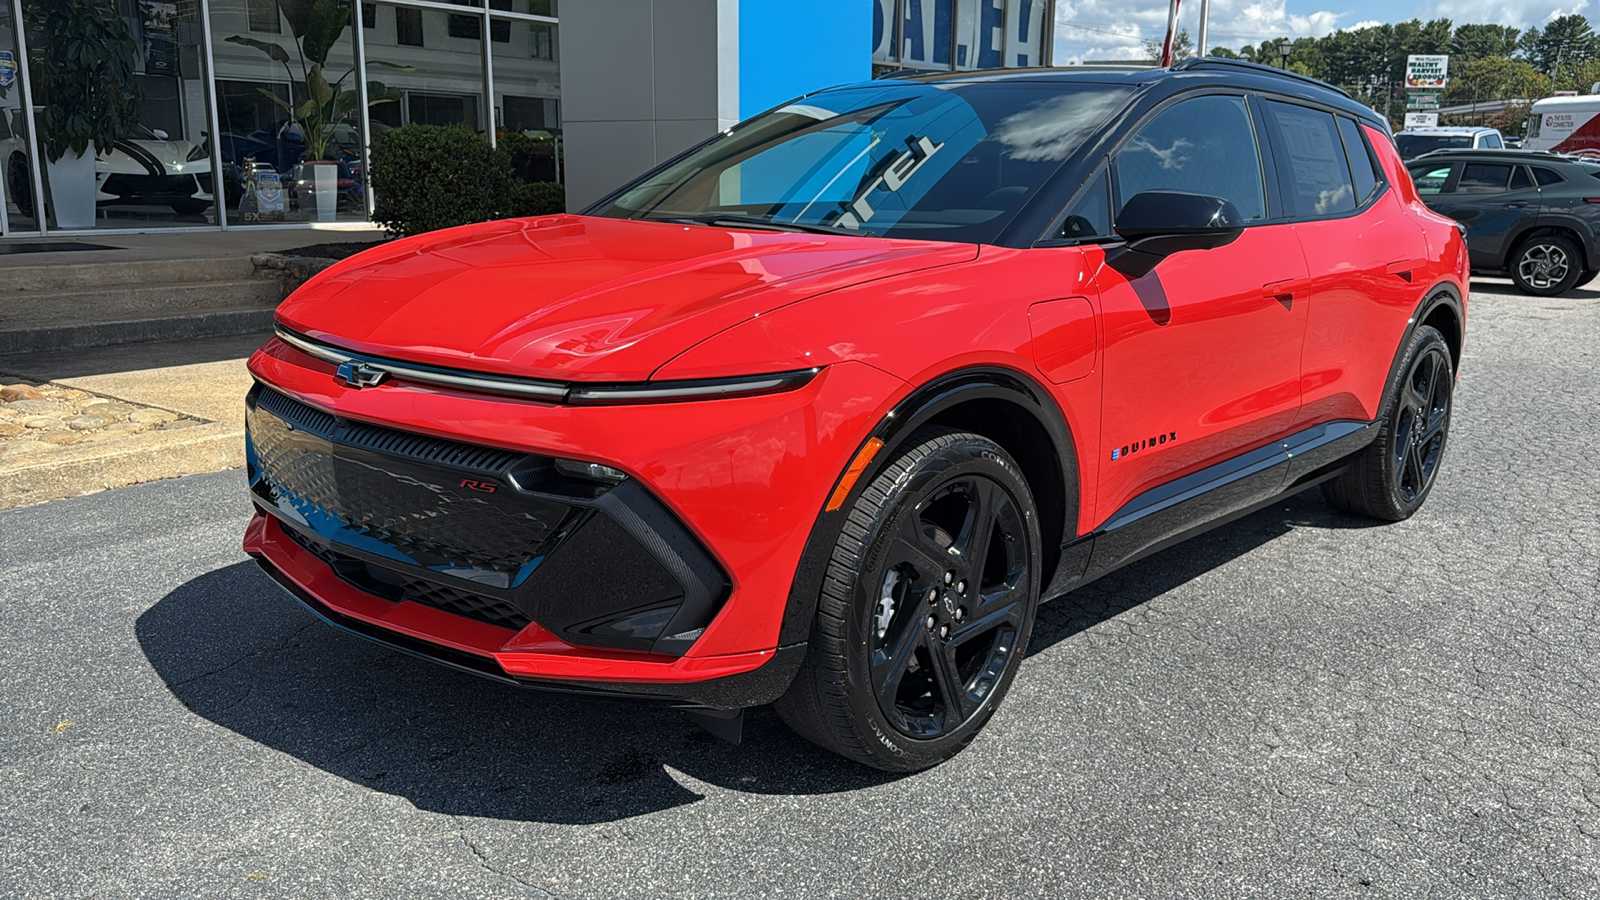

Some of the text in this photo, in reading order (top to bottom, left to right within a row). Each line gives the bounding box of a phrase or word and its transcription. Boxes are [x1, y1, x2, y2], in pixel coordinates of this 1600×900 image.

[873, 0, 1032, 68] ALE!
[1111, 431, 1176, 461] EQUINOX
[460, 479, 498, 493] RS
